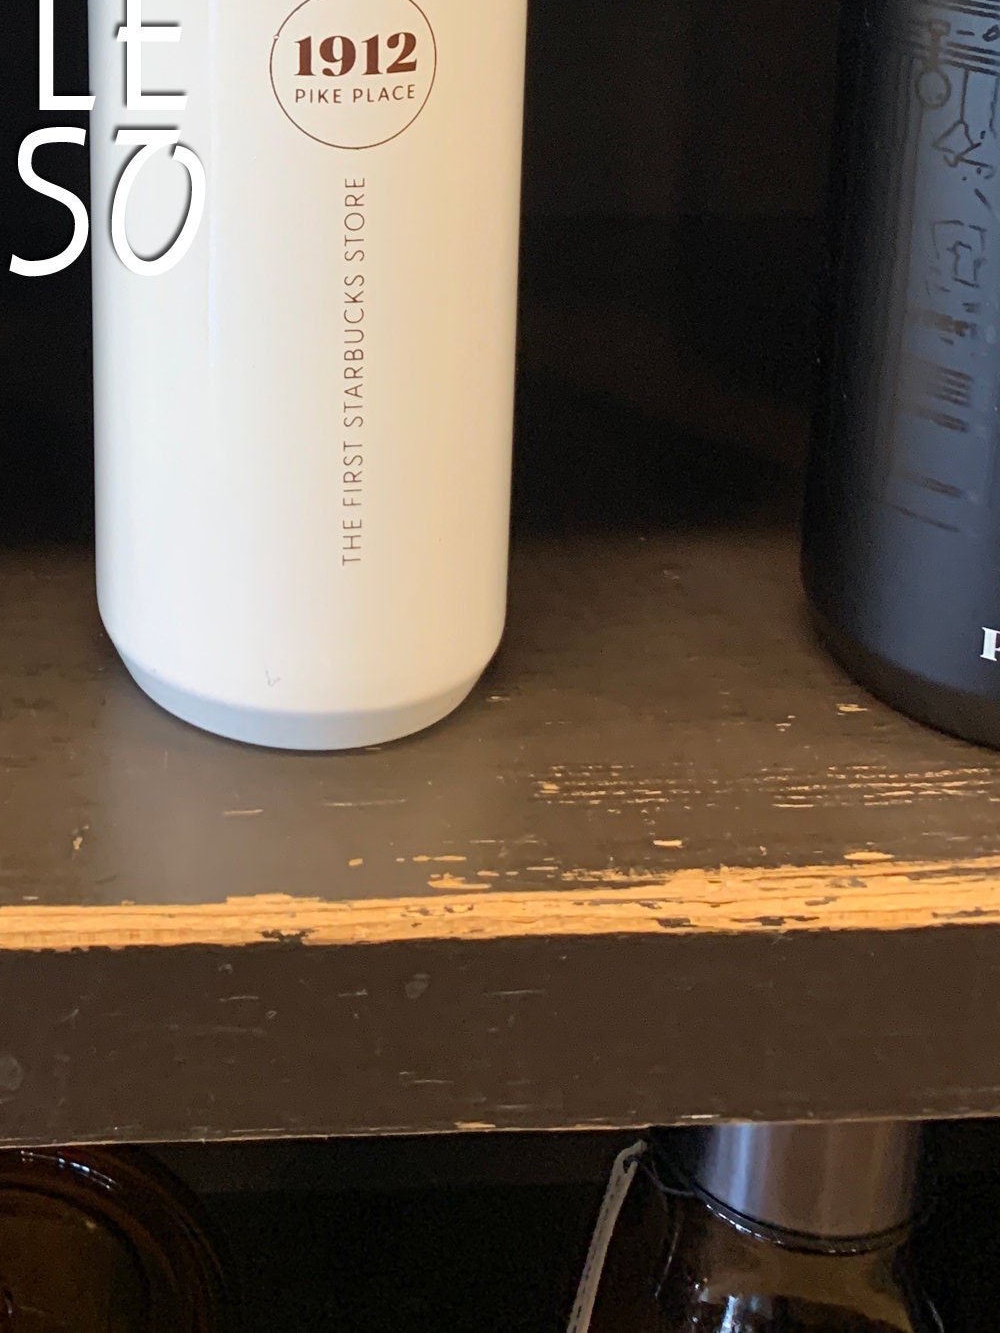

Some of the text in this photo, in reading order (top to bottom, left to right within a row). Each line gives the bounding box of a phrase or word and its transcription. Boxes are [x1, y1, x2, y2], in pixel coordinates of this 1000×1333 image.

[293, 31, 418, 78] 1912
[295, 83, 416, 104] PIKE PLACE
[342, 176, 367, 567] THE FIRST STARBUCKS STORE
